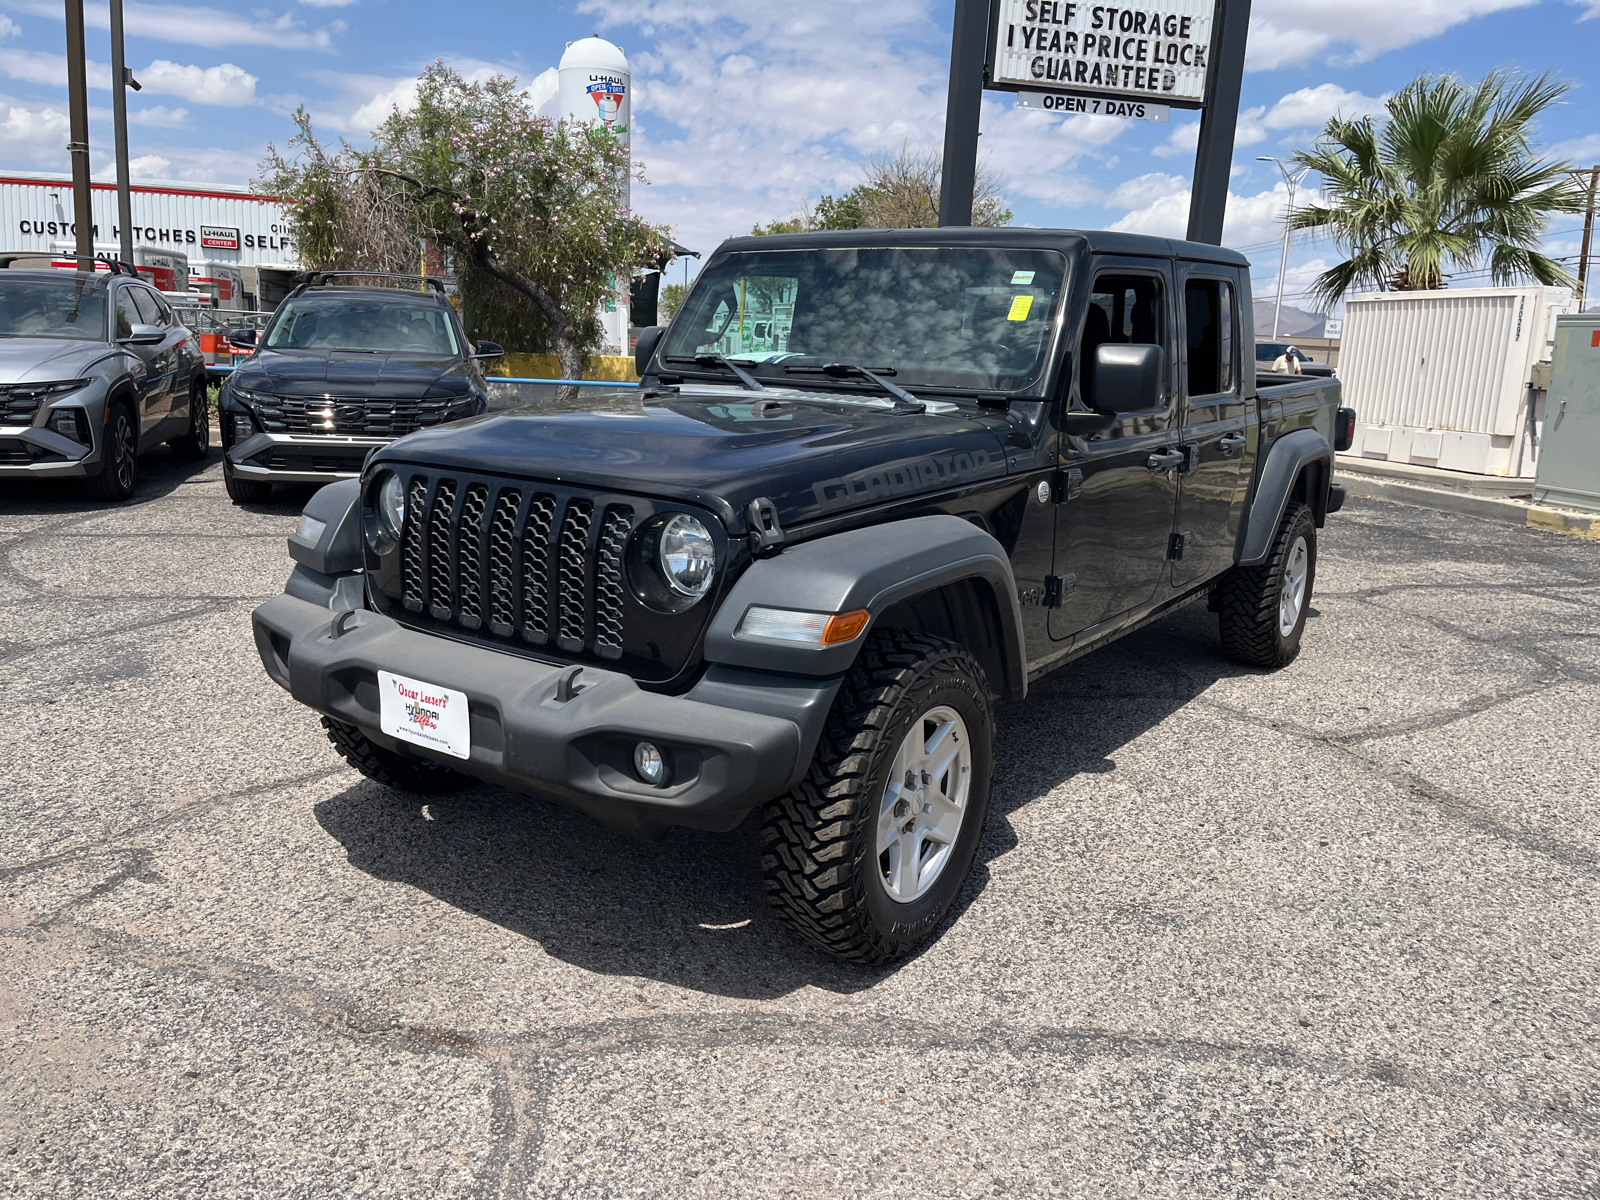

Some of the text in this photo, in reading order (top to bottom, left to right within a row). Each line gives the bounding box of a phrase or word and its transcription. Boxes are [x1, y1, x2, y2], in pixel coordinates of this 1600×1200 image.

[1025, 0, 1192, 39] SELF STORAGE
[1022, 26, 1079, 54] YEAR
[1083, 33, 1148, 62] PRICE
[1153, 40, 1208, 68] LOCK
[589, 74, 624, 86] U-HAUL
[1030, 56, 1176, 91] GUARANTEED
[590, 83, 607, 92] OPEN
[1043, 95, 1146, 118] OPEN 7 DAYS
[113, 225, 196, 243] HTCHES
[203, 230, 236, 238] U-HAUL
[207, 239, 233, 247] CENTER
[812, 449, 991, 509] GLADIATOR
[398, 683, 419, 700] Oscar
[405, 703, 440, 721] HYUNDAI
